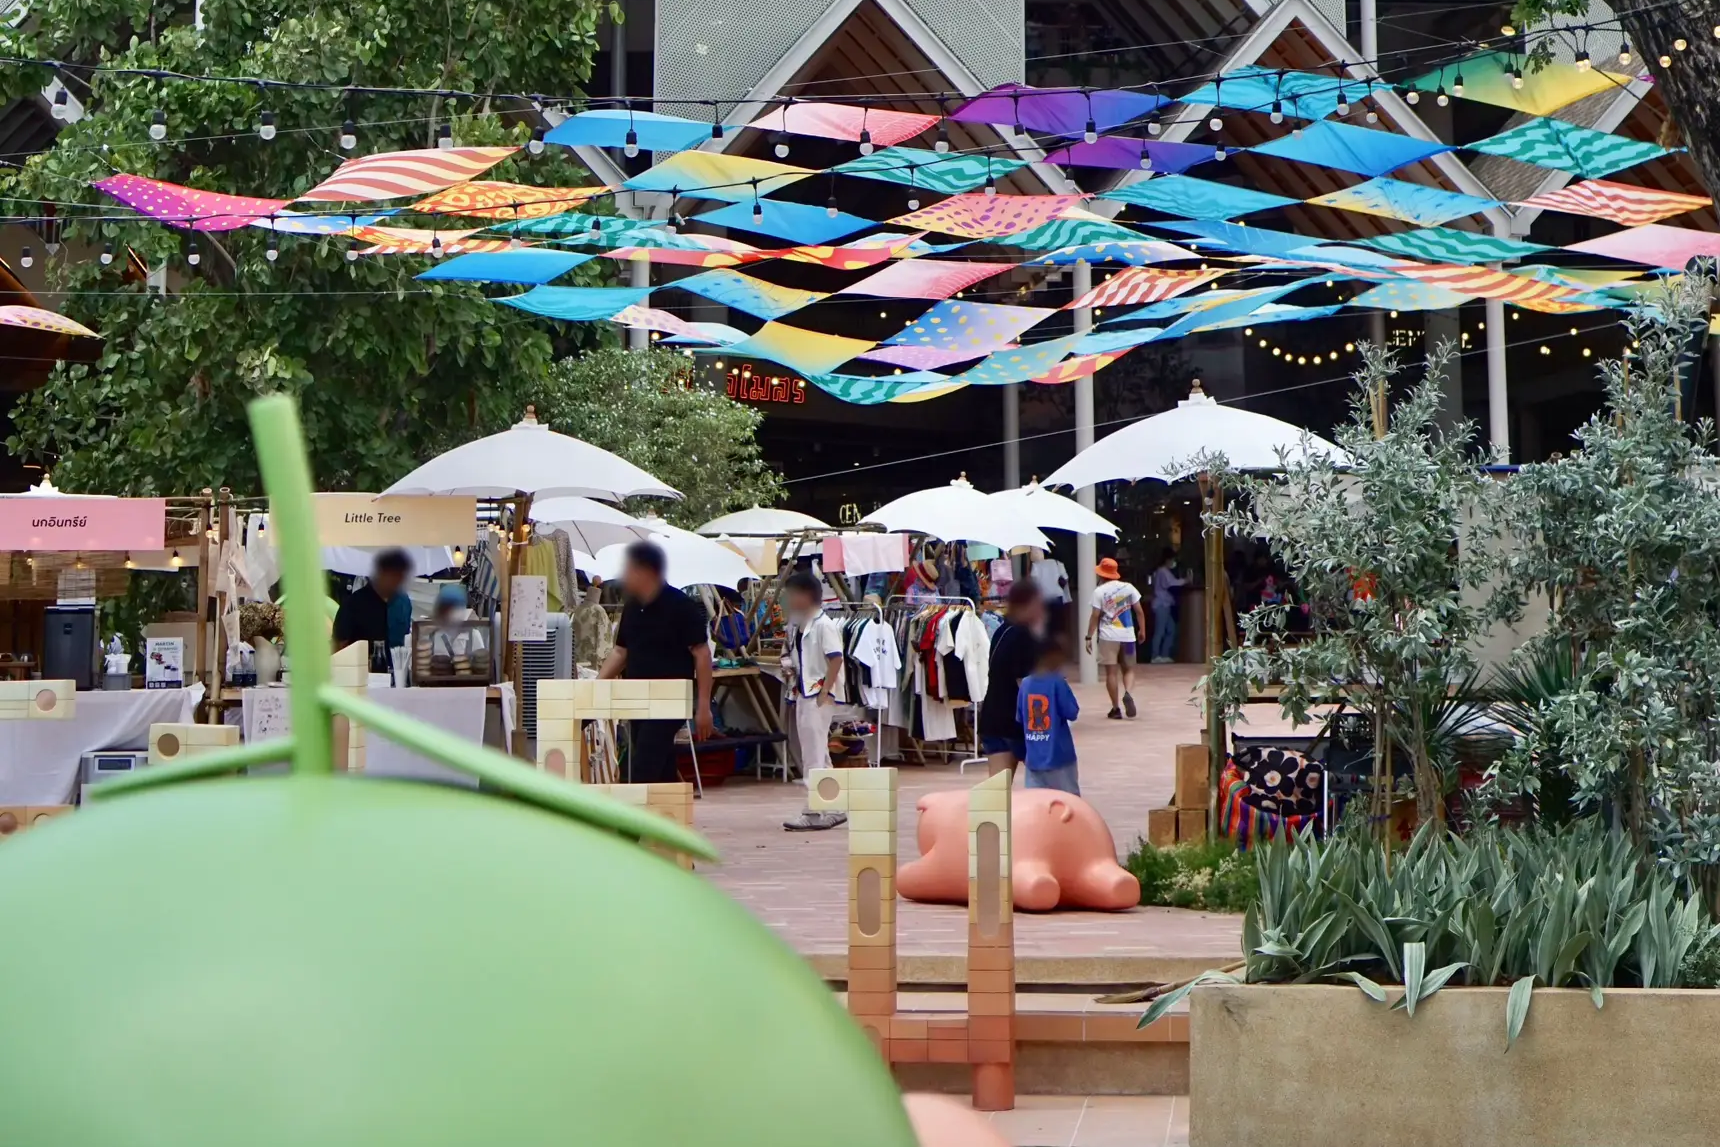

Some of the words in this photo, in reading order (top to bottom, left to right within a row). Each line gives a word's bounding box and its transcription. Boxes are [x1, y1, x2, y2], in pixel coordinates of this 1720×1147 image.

[32, 515, 88, 528] นกอินทรีย์
[344, 512, 374, 524] Little
[377, 512, 402, 524] Tree
[1026, 733, 1051, 742] HAPPY
